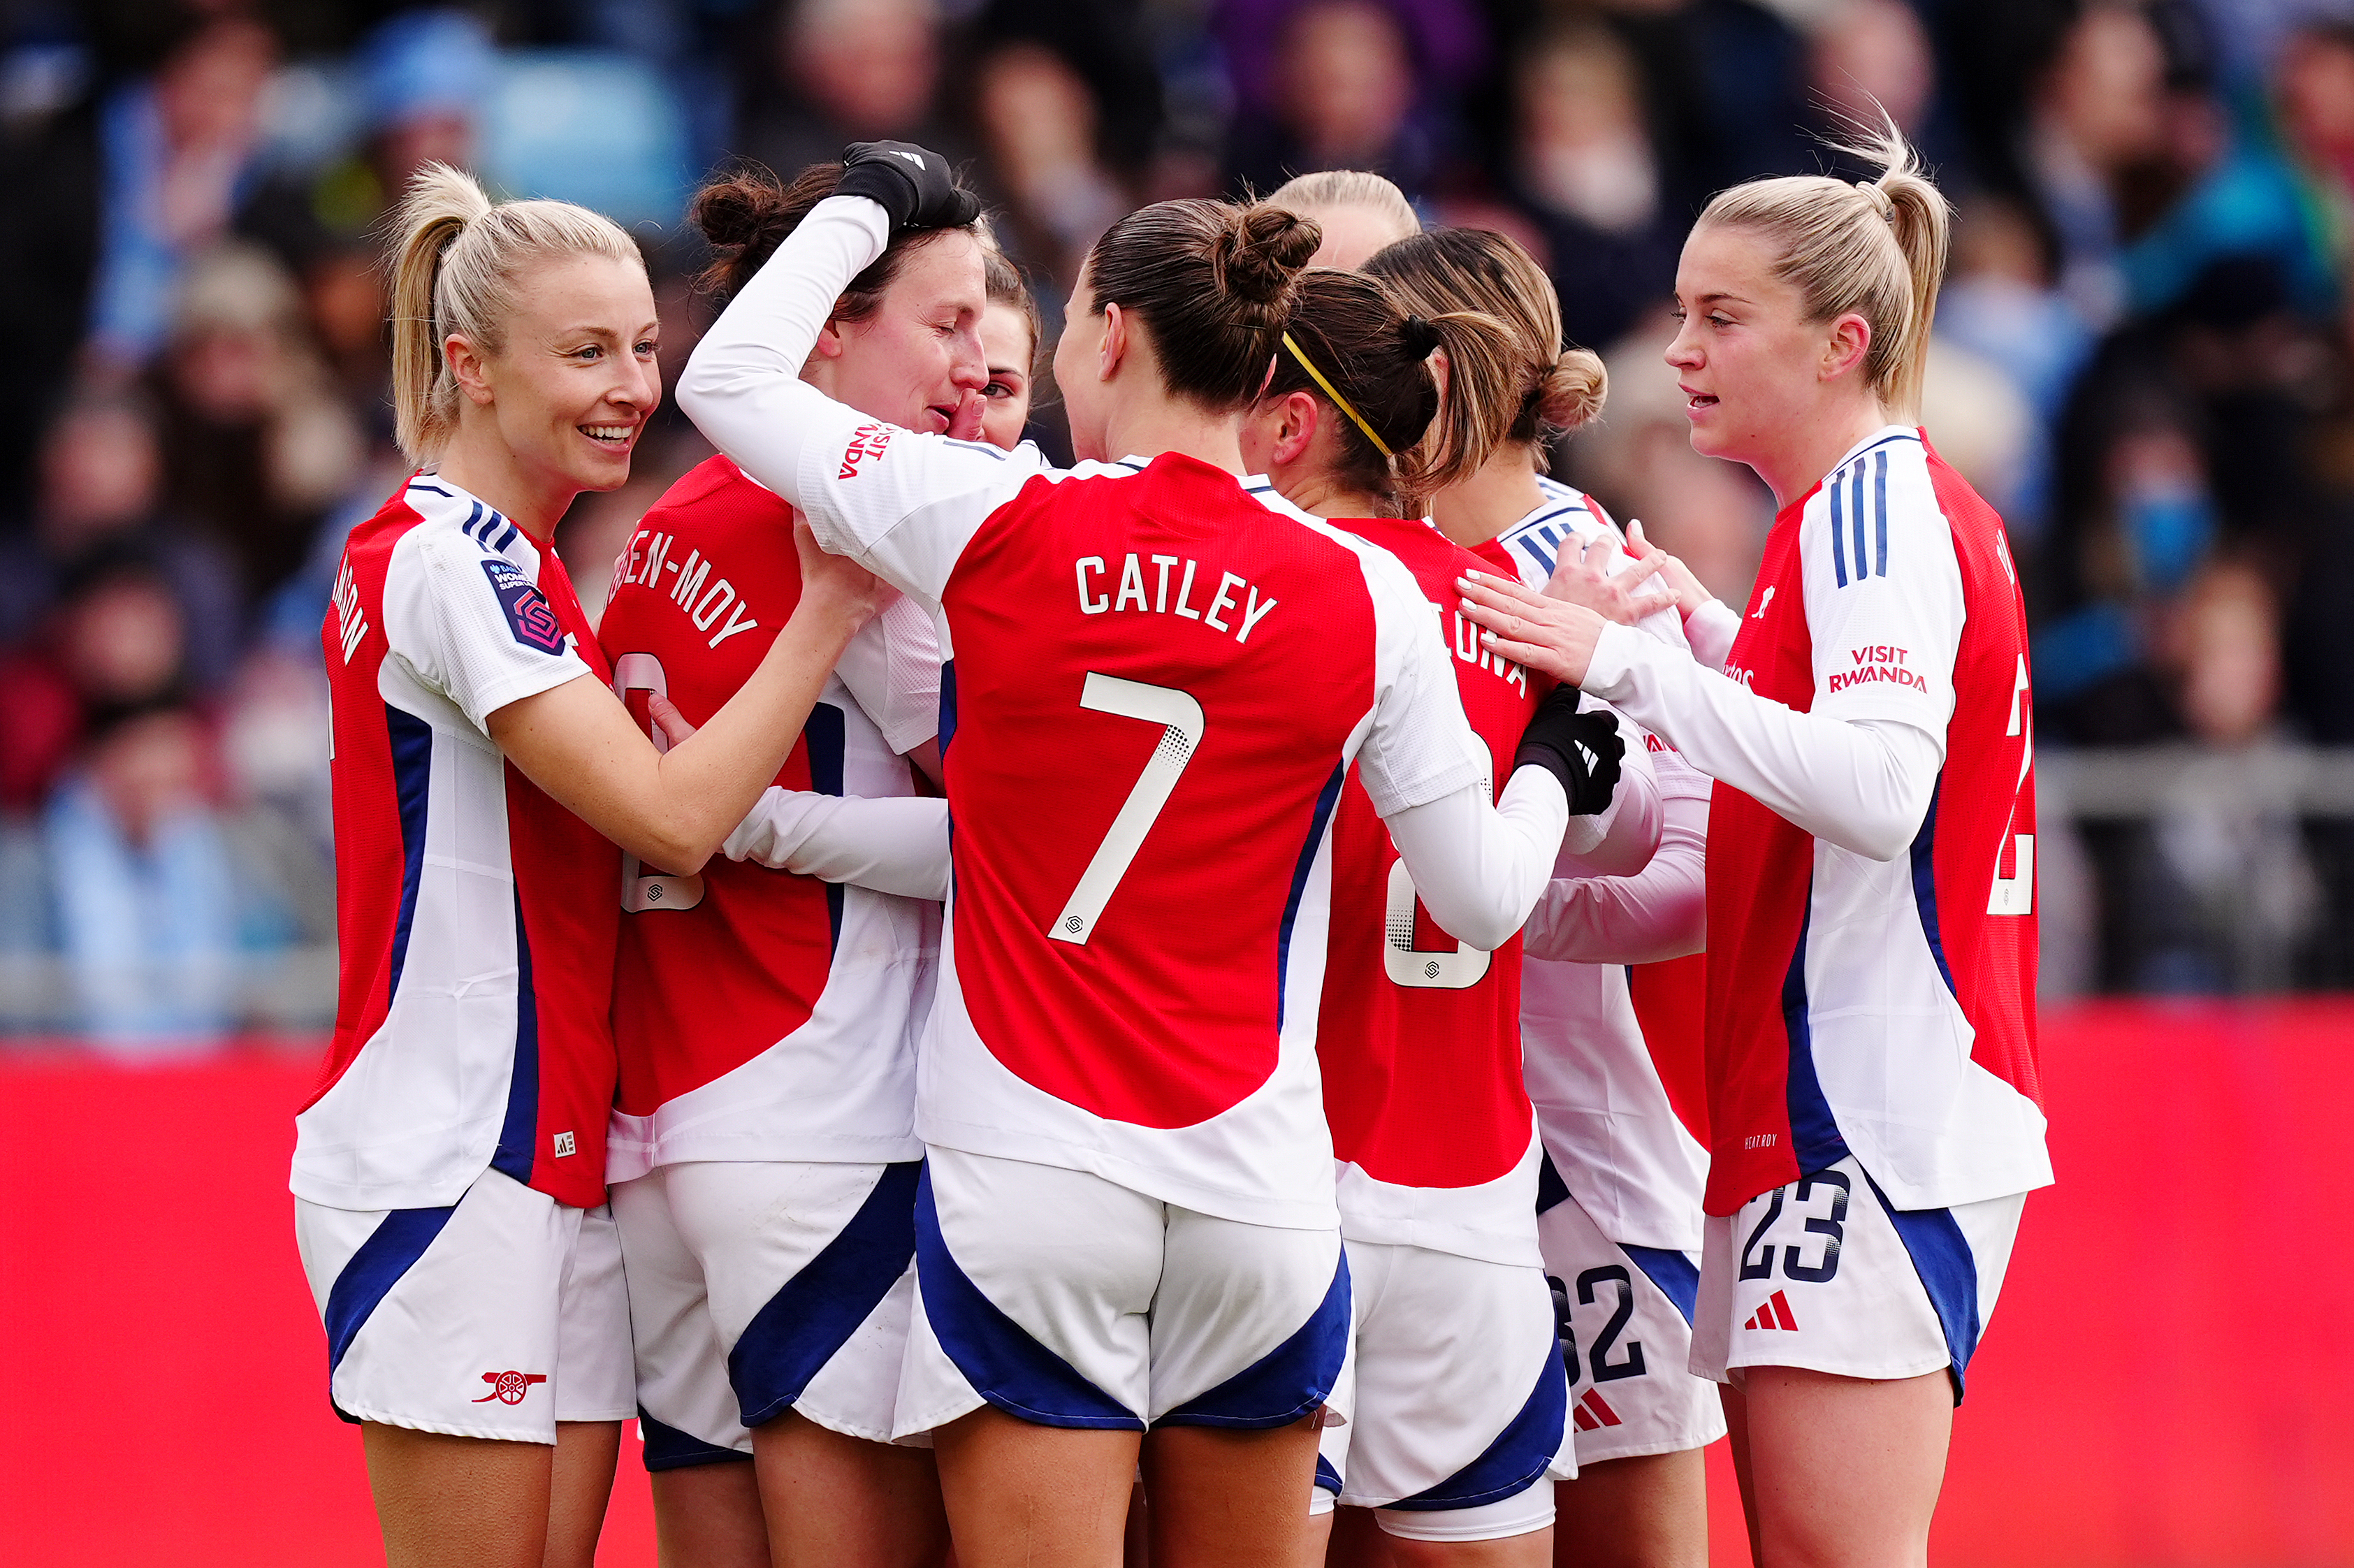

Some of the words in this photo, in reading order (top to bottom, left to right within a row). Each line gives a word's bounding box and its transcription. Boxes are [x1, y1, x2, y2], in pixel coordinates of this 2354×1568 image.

[1075, 553, 1279, 644] CATLEY
[1829, 665, 1928, 695] RWANDA
[1850, 645, 1908, 665] VISIT
[1047, 669, 1206, 946] 7
[1738, 1168, 1852, 1284] 23
